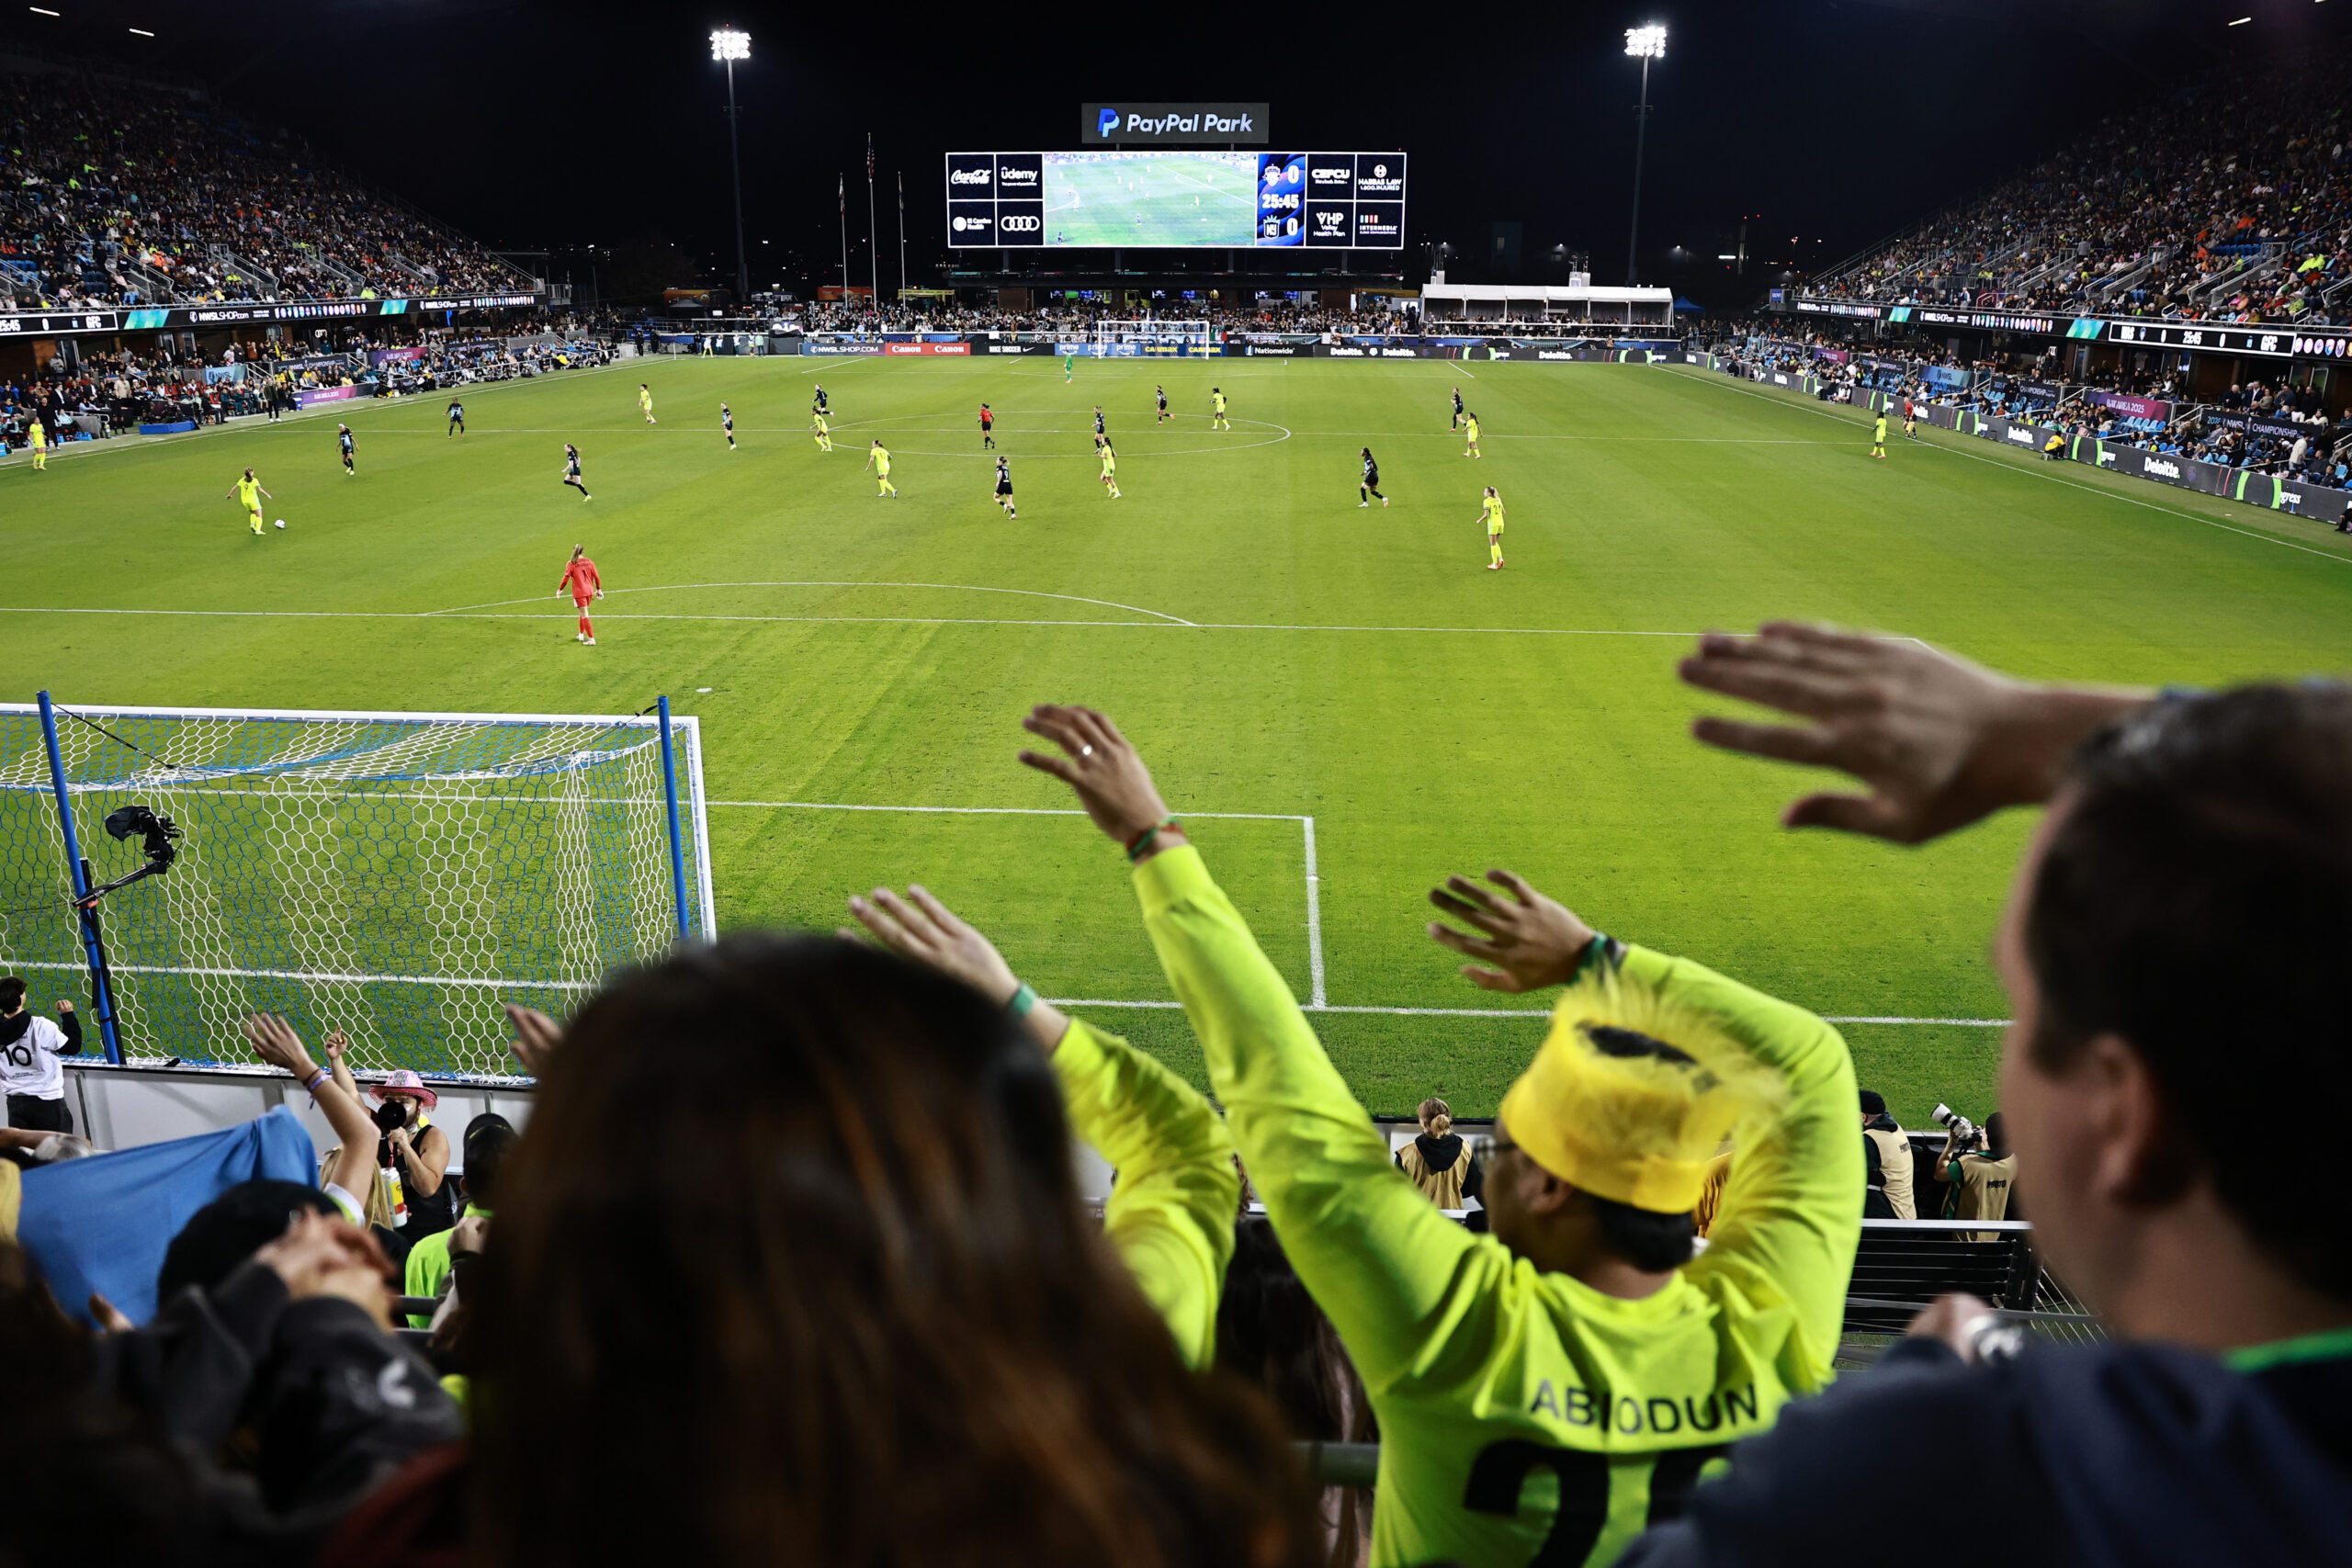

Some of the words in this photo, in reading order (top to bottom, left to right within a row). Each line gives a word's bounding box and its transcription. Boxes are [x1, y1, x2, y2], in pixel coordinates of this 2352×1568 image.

[1126, 113, 1199, 135] PayPal
[1204, 113, 1253, 132] Park
[1288, 164, 1300, 184] 0
[1311, 169, 1351, 179] CEFCU
[1261, 194, 1299, 209] 25:45
[1316, 212, 1344, 225] VHP
[1286, 218, 1298, 236] 0
[41, 318, 50, 331] 0
[85, 315, 102, 329] GFC
[2160, 329, 2167, 343] 0
[2182, 331, 2202, 345] 25:45
[2219, 333, 2226, 348] 0
[2260, 334, 2278, 352] GFC
[891, 344, 922, 353] Canon
[934, 344, 965, 353] Canon
[1254, 346, 1295, 355] Nationwide
[2131, 402, 2145, 413] 2025
[2226, 419, 2245, 430] NWSL
[2252, 423, 2298, 438] CHAMPIONSHIP
[2143, 457, 2180, 479] Deloitte.
[0, 1045, 32, 1066] 10
[1986, 1179, 2007, 1190] PHOTO
[1530, 1378, 1758, 1436] ABIODUN
